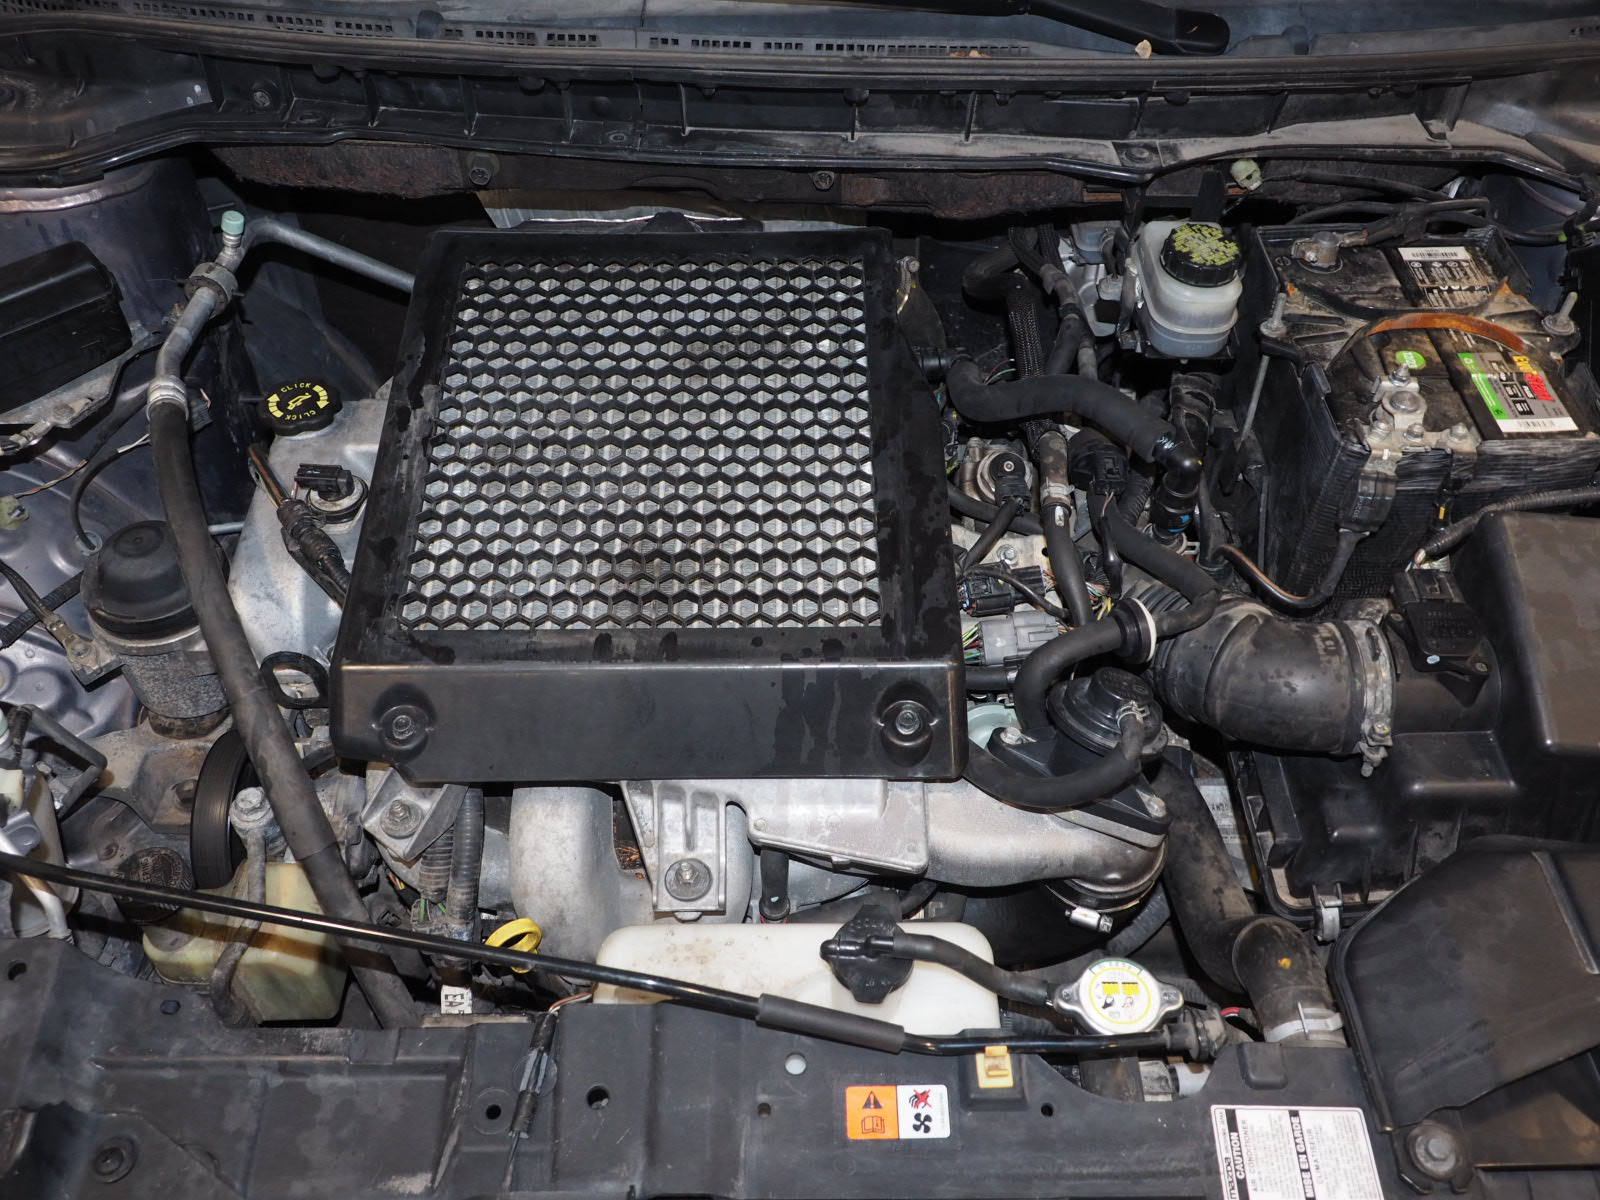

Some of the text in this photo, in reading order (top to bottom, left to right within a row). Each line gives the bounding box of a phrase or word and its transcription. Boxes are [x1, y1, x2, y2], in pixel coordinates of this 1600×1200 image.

[280, 382, 312, 393] CLICK
[284, 409, 317, 420] CLICK
[1230, 1131, 1245, 1180] CAUTION
[1241, 1119, 1259, 1192] AIR CONDITIONER
[1290, 1116, 1315, 1198] MISE EN GARDE
[1306, 1128, 1324, 1185] CLIMATISEUR
